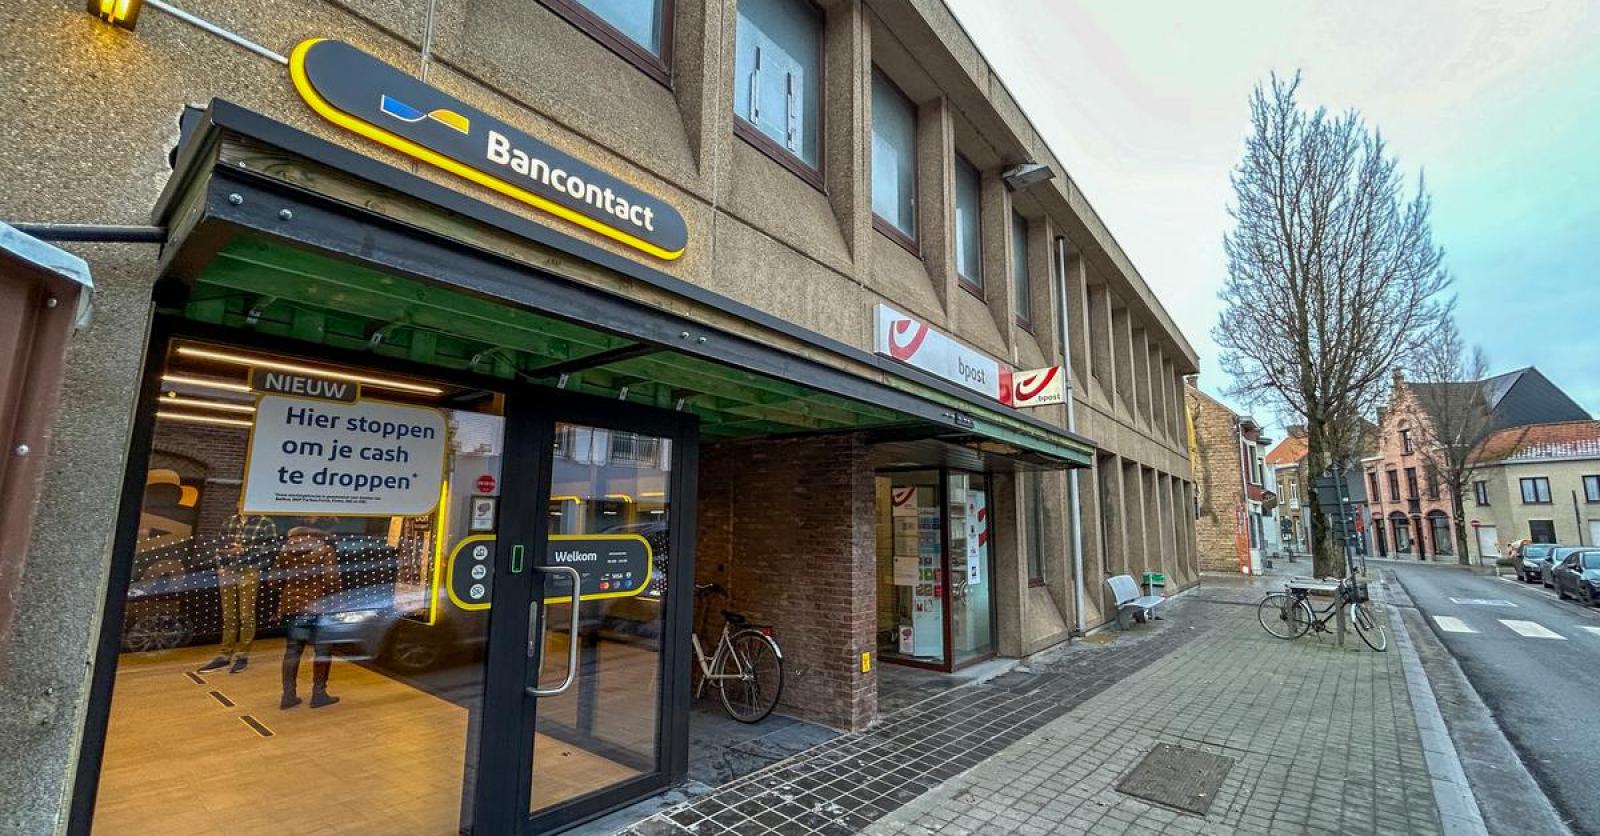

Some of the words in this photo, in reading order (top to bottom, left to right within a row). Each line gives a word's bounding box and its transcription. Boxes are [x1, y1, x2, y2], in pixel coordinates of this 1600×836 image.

[487, 130, 654, 231] Bancontact
[958, 356, 985, 384] bpost
[265, 372, 348, 399] NIEUW
[1038, 393, 1061, 402] bpost
[286, 406, 340, 429] Hier
[346, 416, 435, 440] stoppen
[282, 439, 323, 457] om
[328, 439, 353, 461] je
[359, 445, 409, 463] cash
[278, 466, 304, 485] te
[555, 551, 597, 562] Welkom
